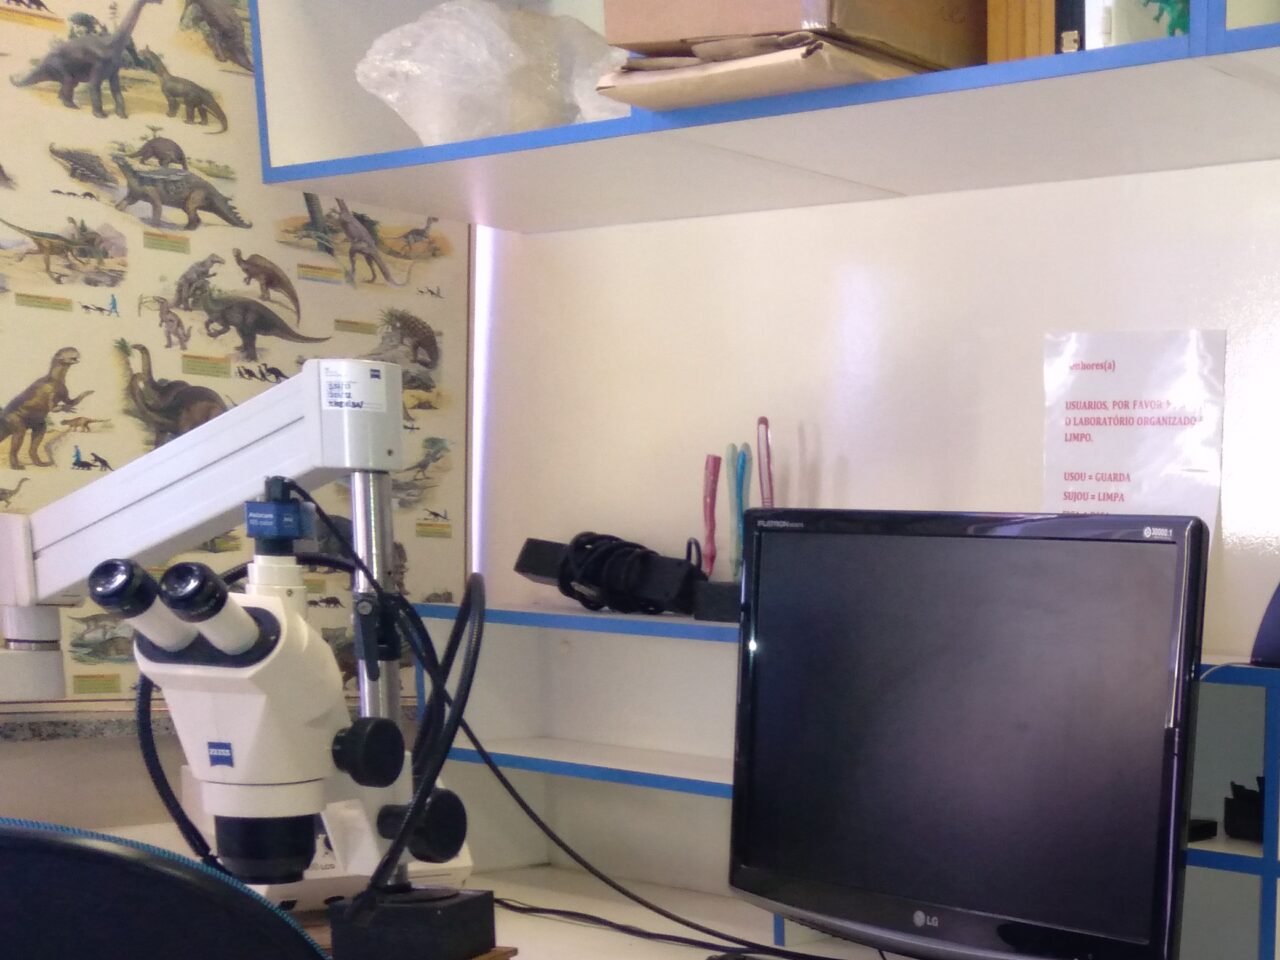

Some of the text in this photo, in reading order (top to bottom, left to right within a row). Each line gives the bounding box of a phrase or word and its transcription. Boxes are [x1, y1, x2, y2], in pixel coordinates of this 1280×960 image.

[1069, 359, 1116, 371] enhores(a)
[1065, 400, 1109, 411] USUARIOS,
[1112, 400, 1130, 410] POR
[1133, 400, 1163, 410] FAVOR
[1073, 414, 1135, 426] LABORATÓRIO
[1137, 416, 1197, 426] ORGANIZADO
[1064, 433, 1094, 442] LIMPO.
[1063, 472, 1087, 482] USOU
[1095, 472, 1131, 482] GUARDA
[1063, 491, 1089, 502] SUJOU
[1097, 492, 1125, 502] LIMPA
[926, 915, 939, 928] LG
